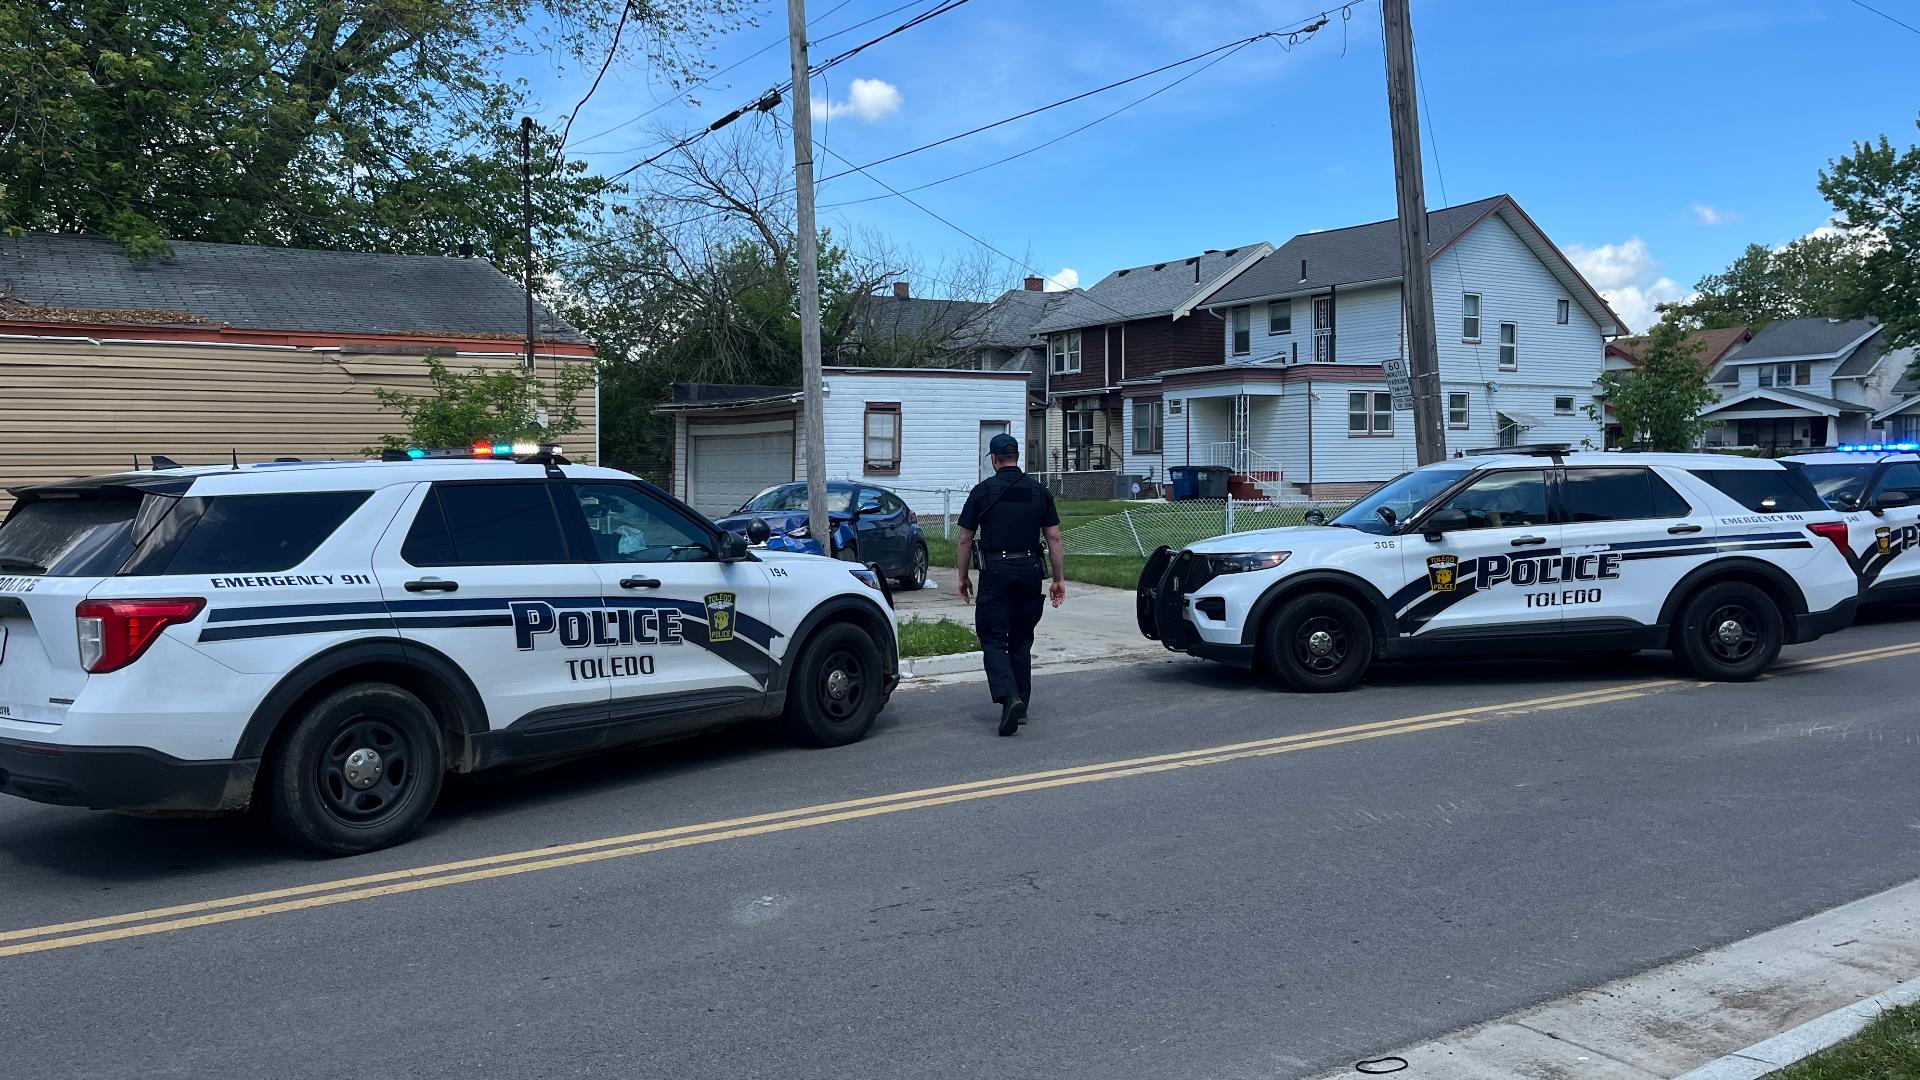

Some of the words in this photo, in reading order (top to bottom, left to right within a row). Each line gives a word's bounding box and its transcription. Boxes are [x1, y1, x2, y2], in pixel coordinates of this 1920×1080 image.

[1388, 362, 1399, 371] 60
[1388, 378, 1407, 386] PARKING
[1721, 514, 1784, 525] EMERGENCY
[1374, 540, 1395, 549] 306
[1431, 556, 1455, 564] TOLEDO
[769, 567, 788, 577] 194
[1475, 553, 1622, 590] POLICE
[211, 575, 334, 589] EMERGENCY
[341, 574, 371, 585] 911
[708, 593, 732, 603] TOLEDO
[1525, 588, 1602, 608] TOLEDO
[509, 601, 683, 651] POLICE
[711, 630, 731, 639] POLICE
[565, 655, 656, 681] TOLEDO
